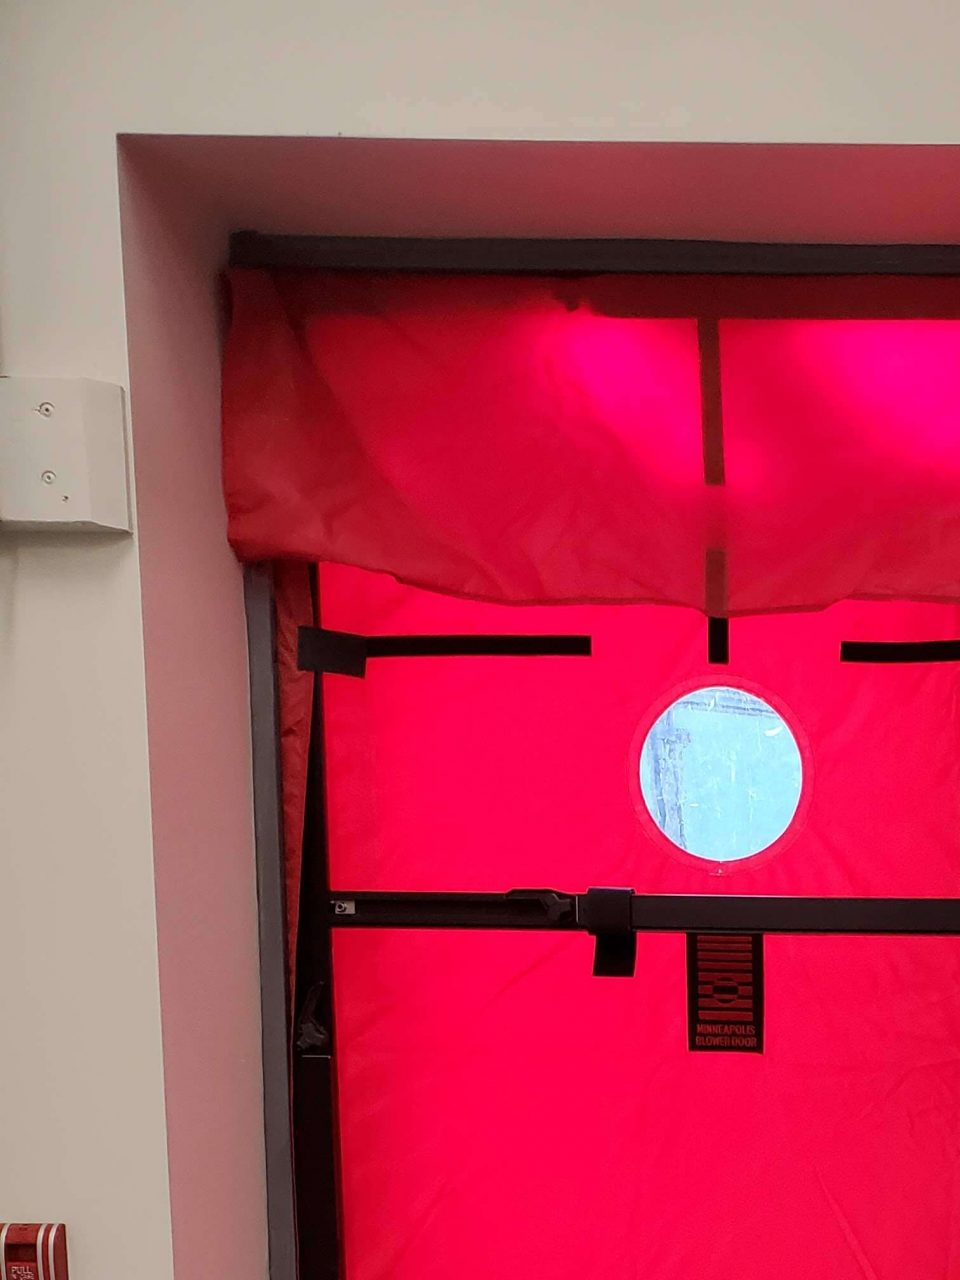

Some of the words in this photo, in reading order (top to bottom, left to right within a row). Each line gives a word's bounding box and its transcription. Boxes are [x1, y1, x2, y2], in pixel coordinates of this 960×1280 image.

[696, 1023, 756, 1035] MINNEAPOLIS
[695, 1035, 731, 1047] BLOWER
[731, 1036, 758, 1048] DOOR
[11, 1265, 33, 1274] PULL
